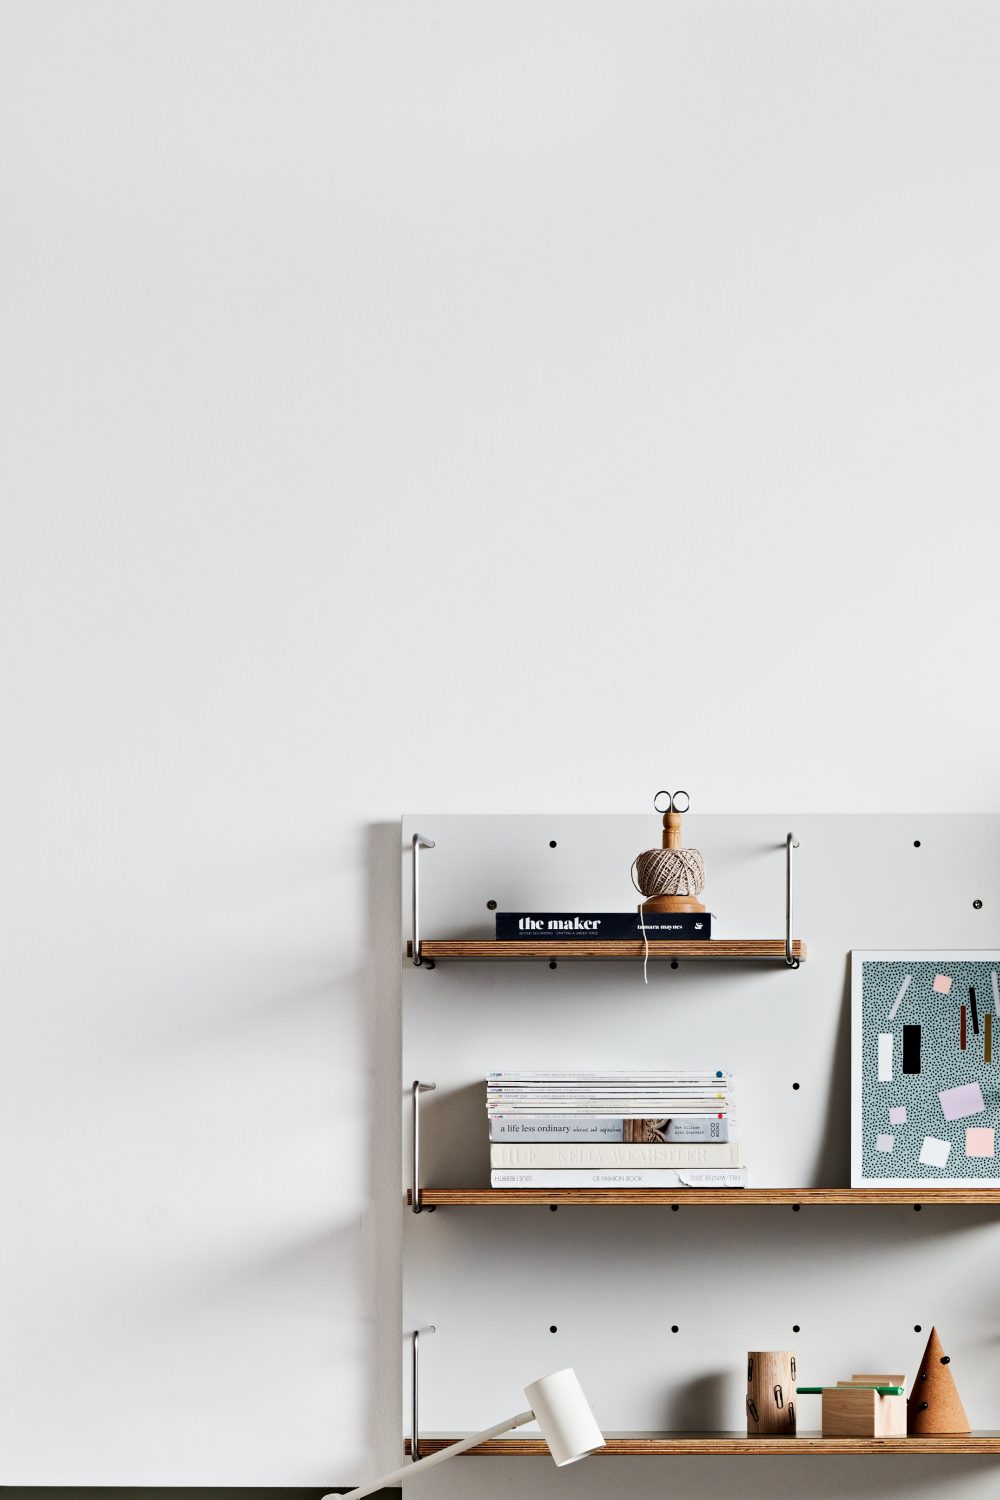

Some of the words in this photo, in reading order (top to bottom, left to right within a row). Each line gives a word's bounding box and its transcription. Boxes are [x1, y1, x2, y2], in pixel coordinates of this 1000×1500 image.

[518, 916, 544, 930] the
[548, 916, 602, 930] maker
[507, 1124, 520, 1132] life
[522, 1124, 536, 1132] less
[537, 1124, 570, 1134] ordinary
[499, 1148, 540, 1164] HUE
[557, 1148, 608, 1164] KELLY
[610, 1148, 708, 1164] WEARSTLER
